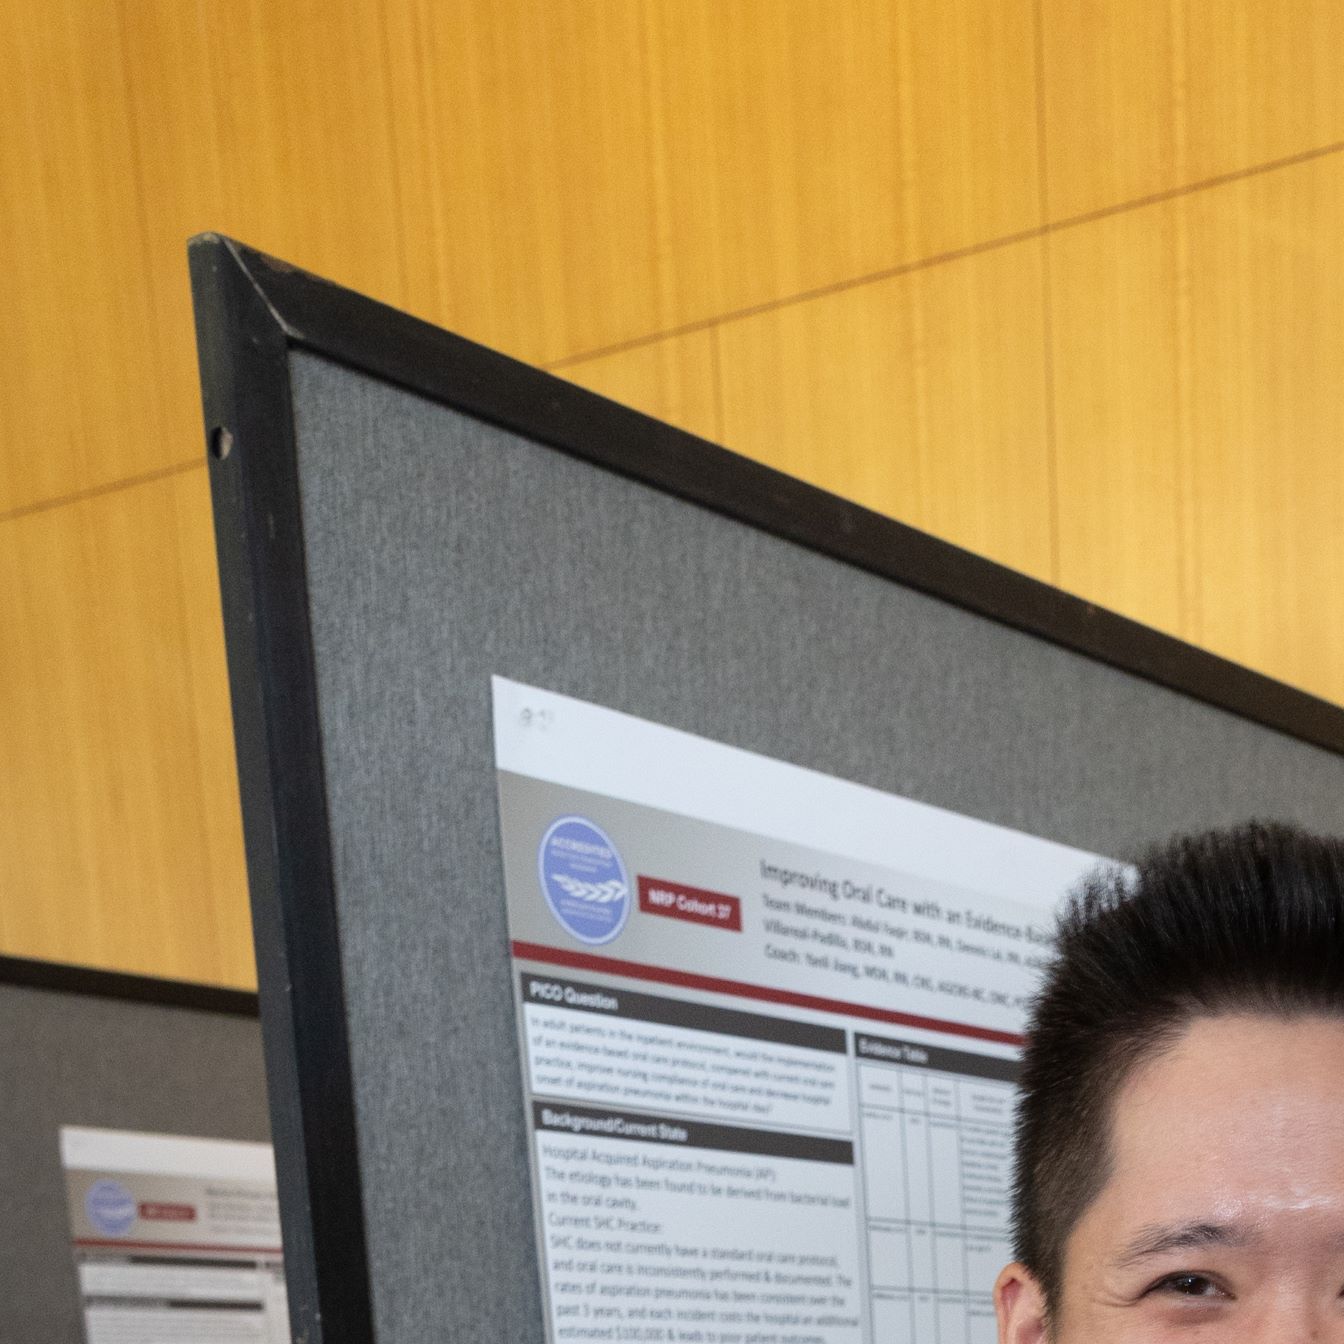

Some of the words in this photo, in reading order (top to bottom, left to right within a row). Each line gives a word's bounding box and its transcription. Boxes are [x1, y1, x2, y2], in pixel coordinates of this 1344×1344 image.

[759, 857, 839, 902] Improving
[840, 877, 873, 906] Oral
[876, 886, 907, 913] Care
[913, 898, 940, 921] with
[947, 908, 960, 926] an
[678, 894, 714, 917] Cohort
[529, 979, 562, 1002] PICO
[564, 985, 619, 1011] Question
[658, 1122, 688, 1142] State
[542, 1144, 587, 1161] Hospital
[548, 1212, 591, 1228] Current
